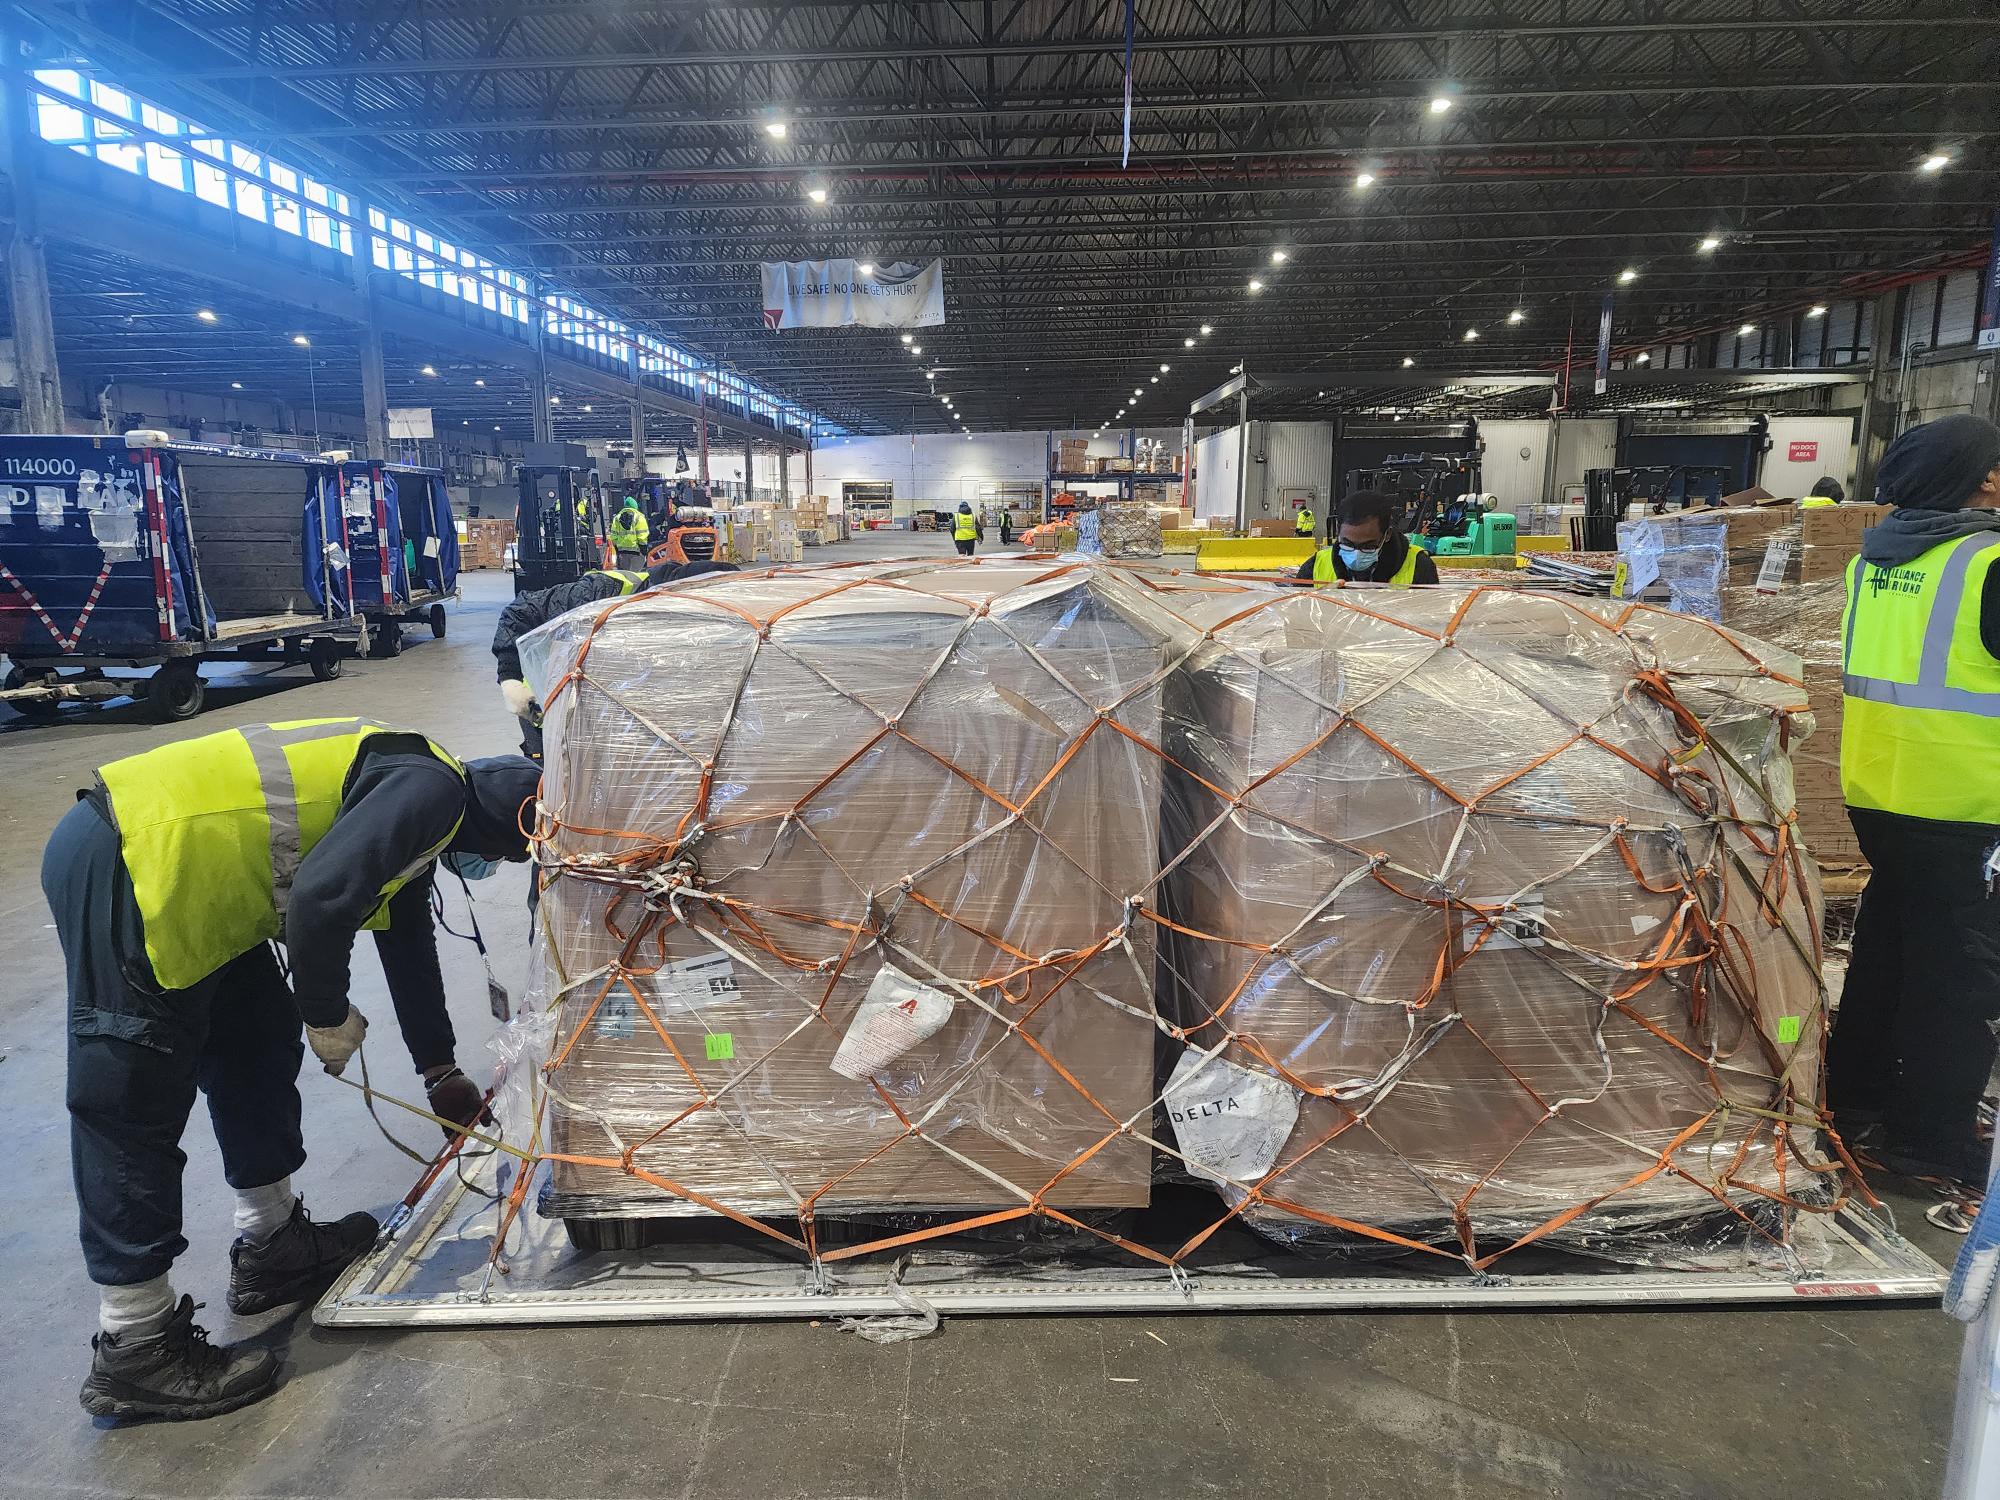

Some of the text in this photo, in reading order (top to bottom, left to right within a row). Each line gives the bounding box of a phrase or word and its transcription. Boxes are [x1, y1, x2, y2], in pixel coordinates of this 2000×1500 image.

[834, 284, 848, 295] NO
[850, 282, 869, 295] ONE
[869, 284, 891, 296] GETS
[892, 284, 918, 296] HURT
[5, 458, 76, 475] 114000
[1770, 540, 1792, 552] BRU
[714, 976, 735, 992] 14
[1172, 1097, 1240, 1123] DELTA
